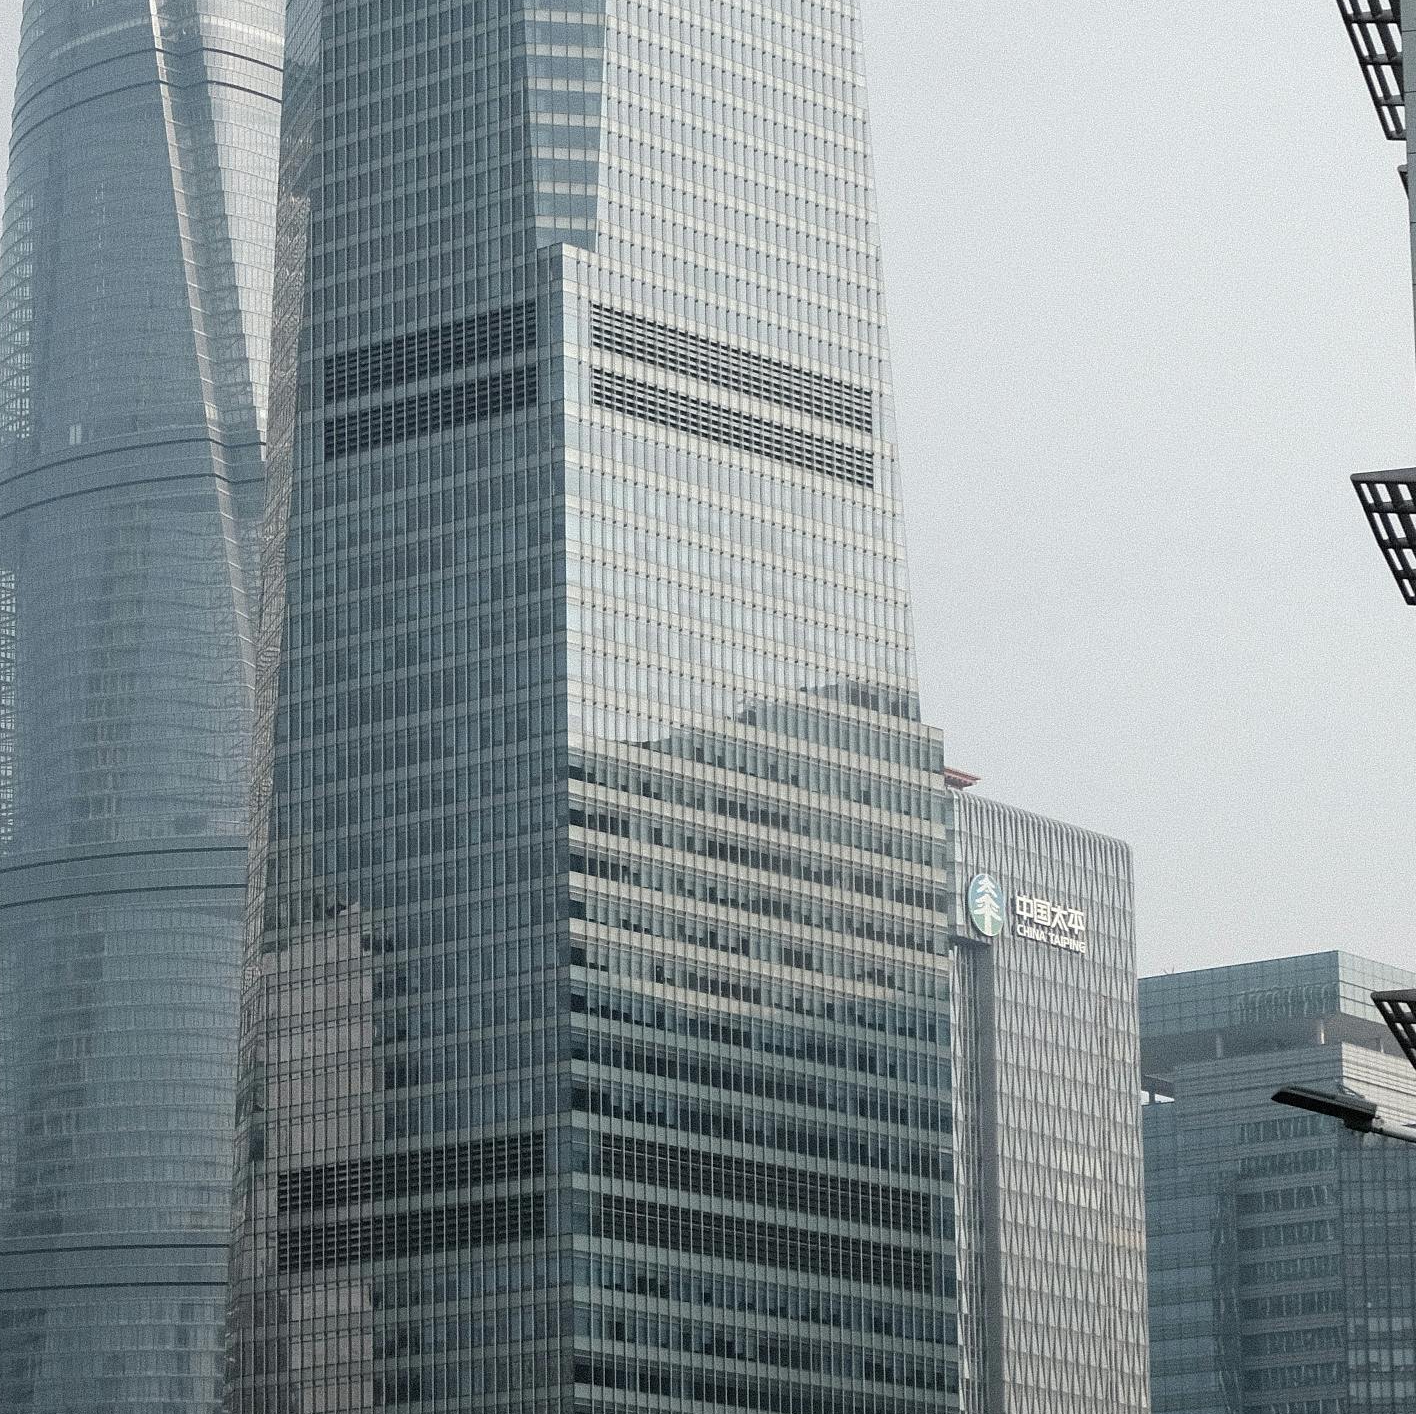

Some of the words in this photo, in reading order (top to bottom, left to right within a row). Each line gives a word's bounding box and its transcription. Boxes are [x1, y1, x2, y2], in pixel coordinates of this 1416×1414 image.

[1015, 894, 1086, 935] 中国太平
[1016, 924, 1047, 943] CHINA
[1048, 932, 1086, 954] TAIPING
